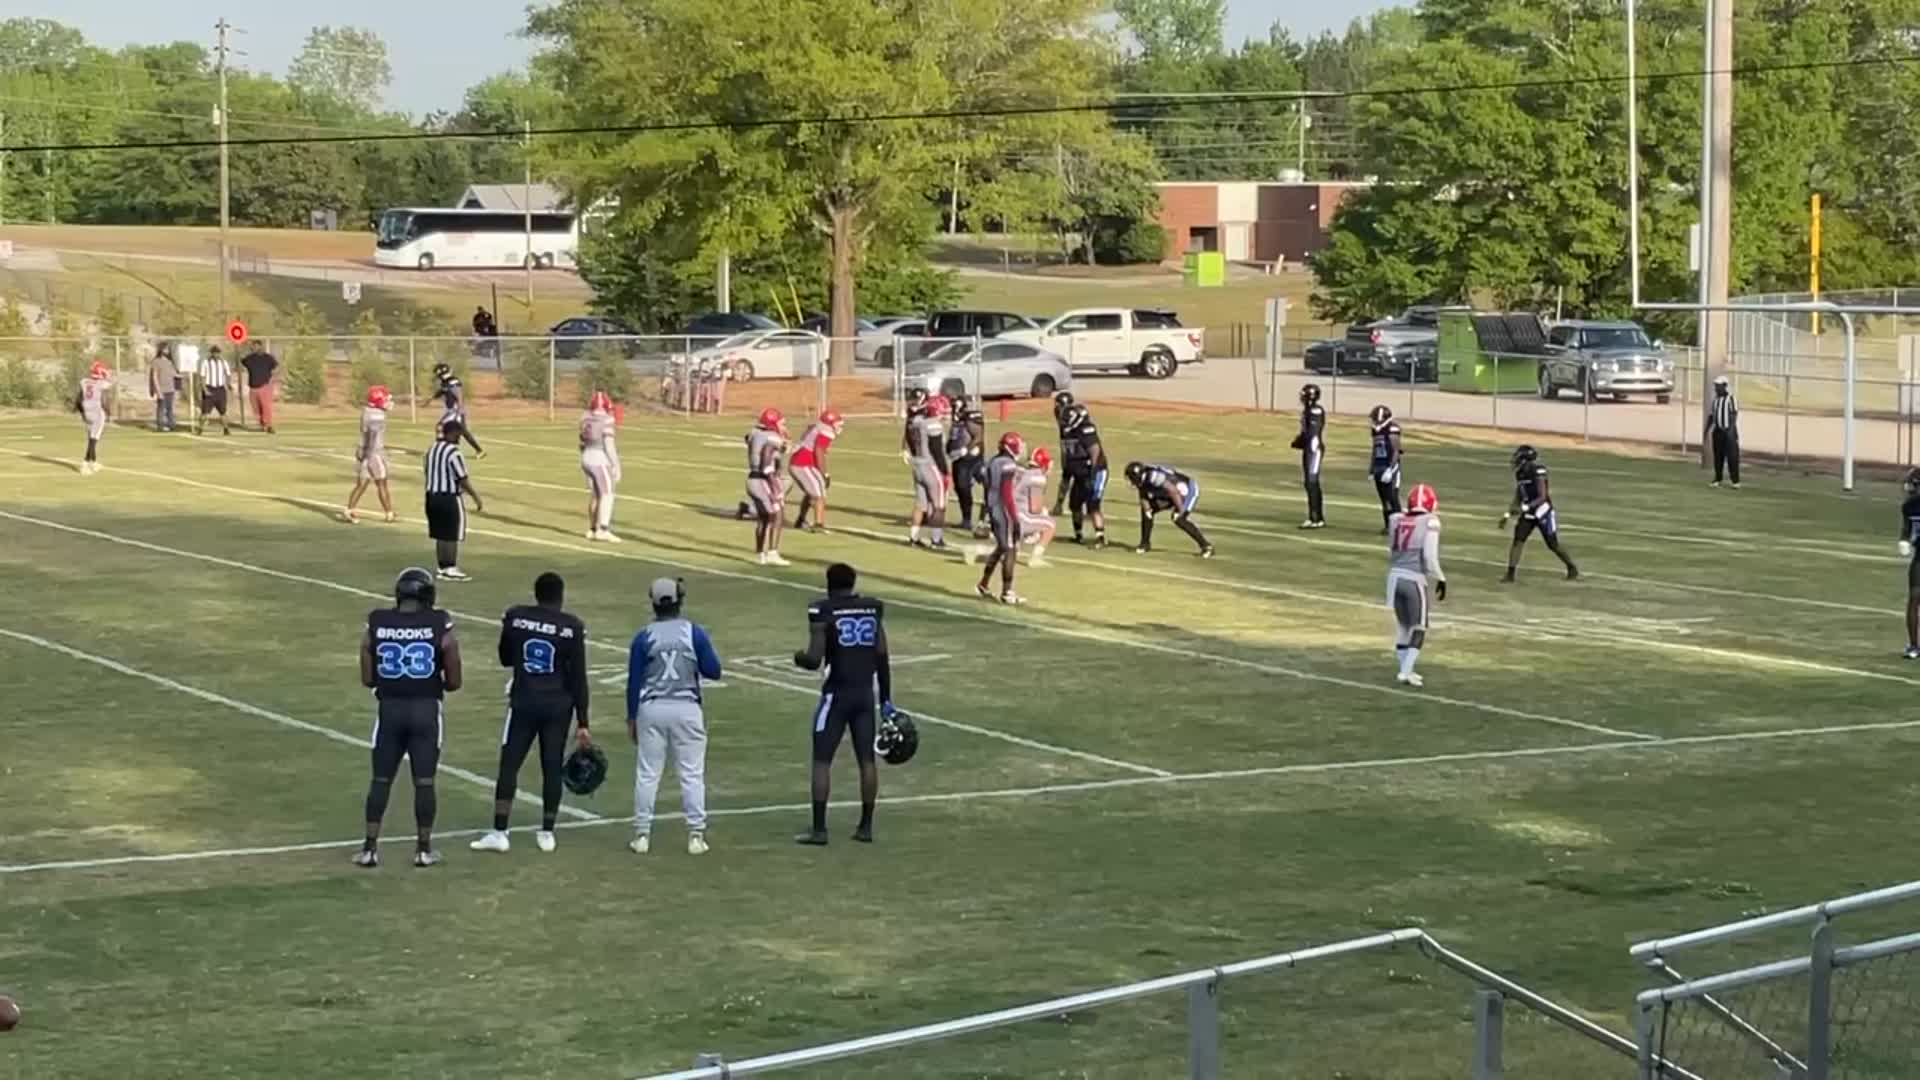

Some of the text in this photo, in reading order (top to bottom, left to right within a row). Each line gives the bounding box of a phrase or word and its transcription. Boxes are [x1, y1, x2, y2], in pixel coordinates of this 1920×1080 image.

[1392, 524, 1416, 551] 17
[376, 627, 433, 639] BROOKS
[836, 617, 877, 646] 32
[376, 642, 435, 679] 33
[523, 639, 555, 672] 9
[661, 650, 680, 680] X
